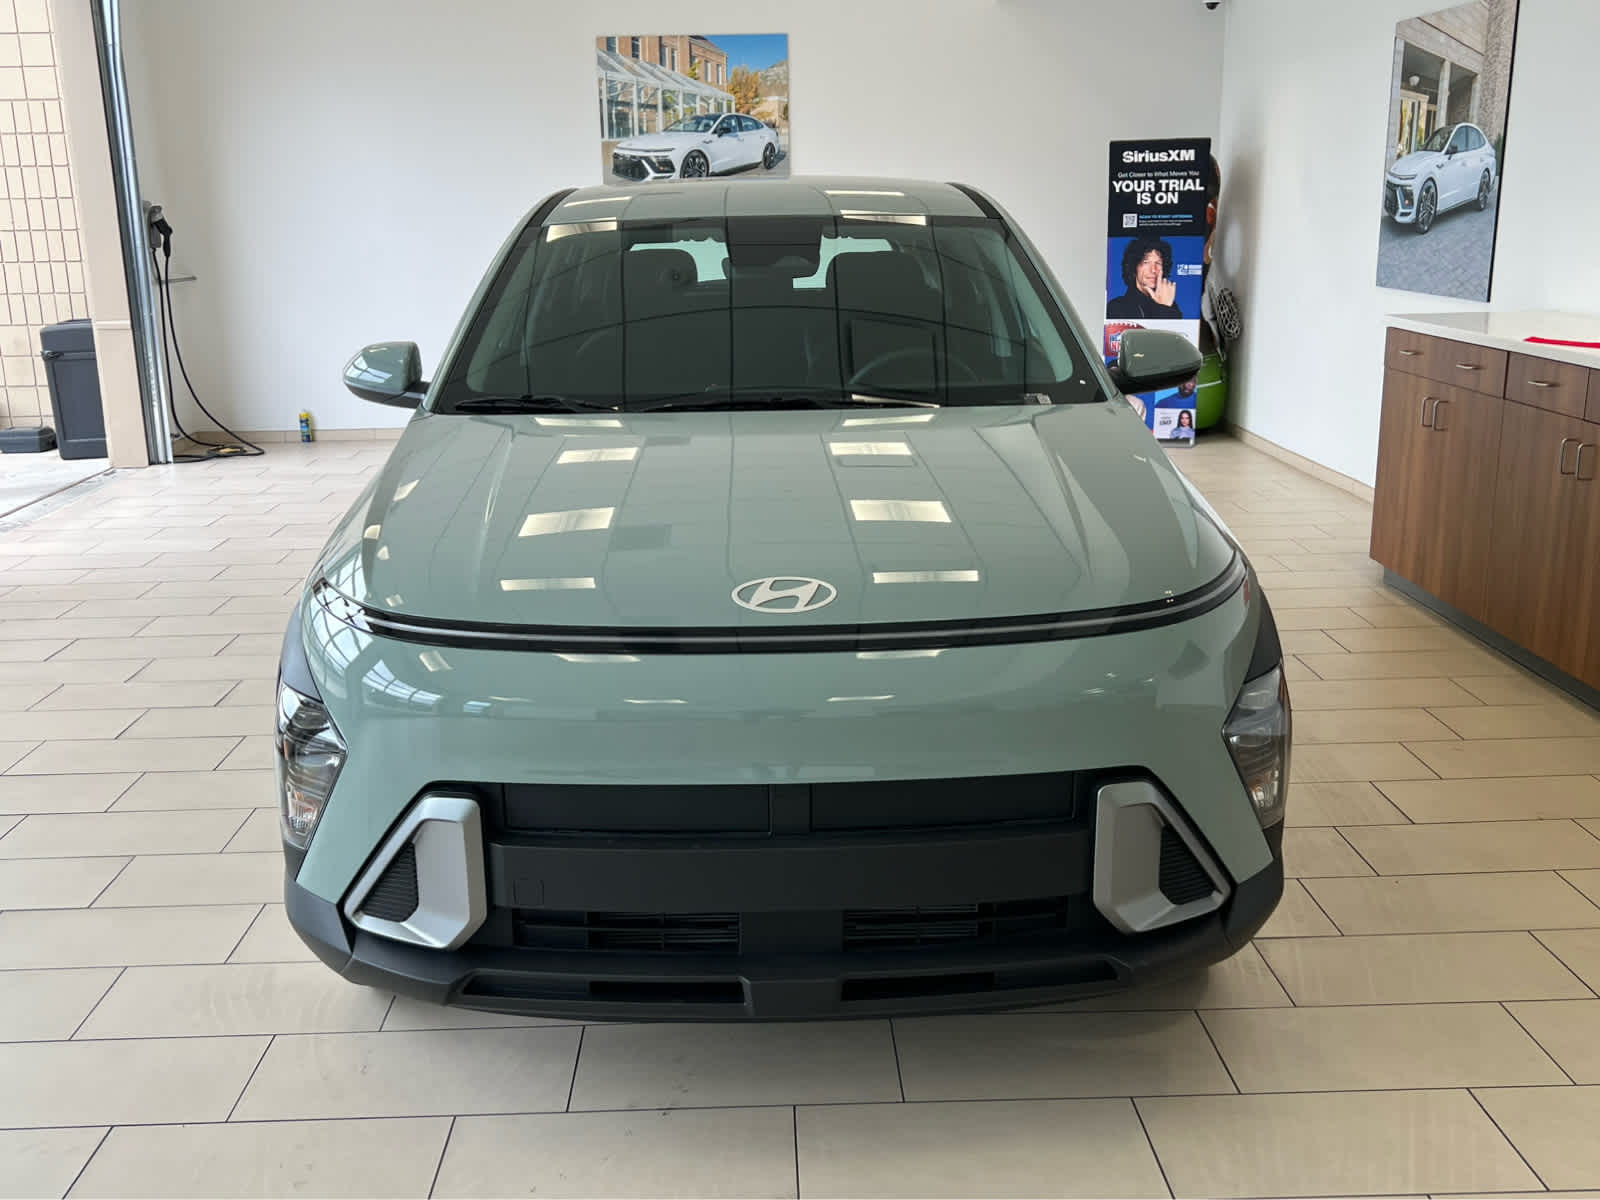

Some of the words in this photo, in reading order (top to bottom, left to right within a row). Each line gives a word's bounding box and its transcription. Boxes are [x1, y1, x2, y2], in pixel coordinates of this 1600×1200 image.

[1122, 149, 1195, 163] SiriusXM
[1112, 179, 1156, 192] YOUR
[1158, 178, 1205, 192] TRIAL
[1136, 192, 1152, 205] IS
[1154, 191, 1179, 204] ON
